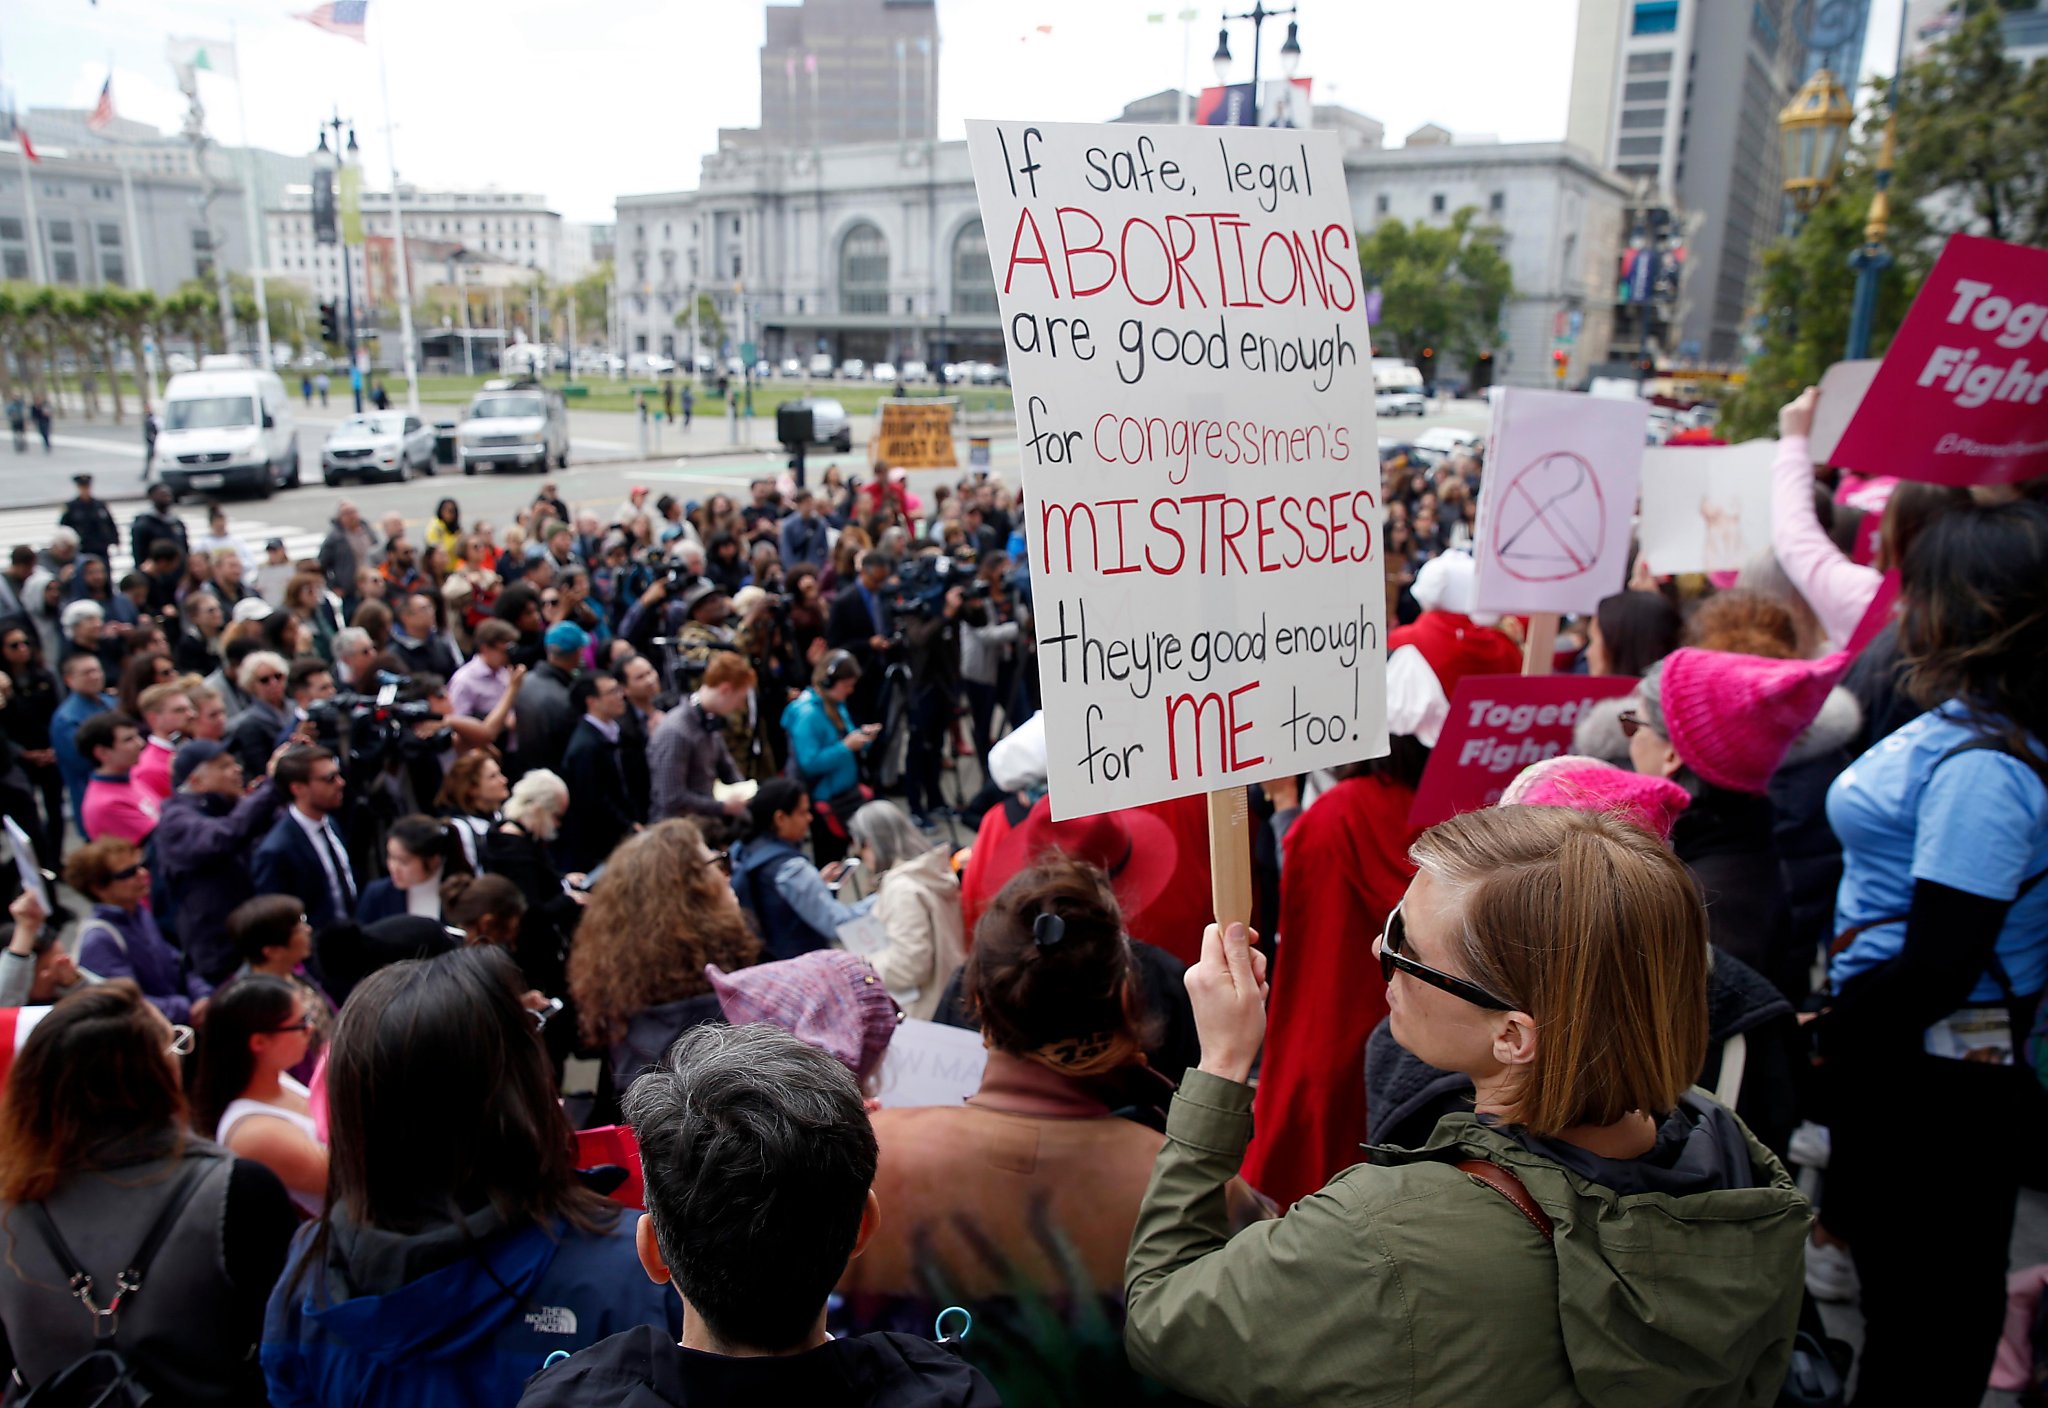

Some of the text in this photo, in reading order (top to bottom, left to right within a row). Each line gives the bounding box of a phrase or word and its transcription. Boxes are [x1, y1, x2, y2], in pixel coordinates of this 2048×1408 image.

[997, 127, 1312, 212] If safe, legal
[1004, 206, 1355, 312] ABORTIONS
[1012, 312, 1356, 391] are good enough
[1025, 396, 1083, 465] for
[1040, 598, 1377, 698] they're good enough
[1078, 704, 1145, 784] for
[1280, 667, 1361, 751] too!
